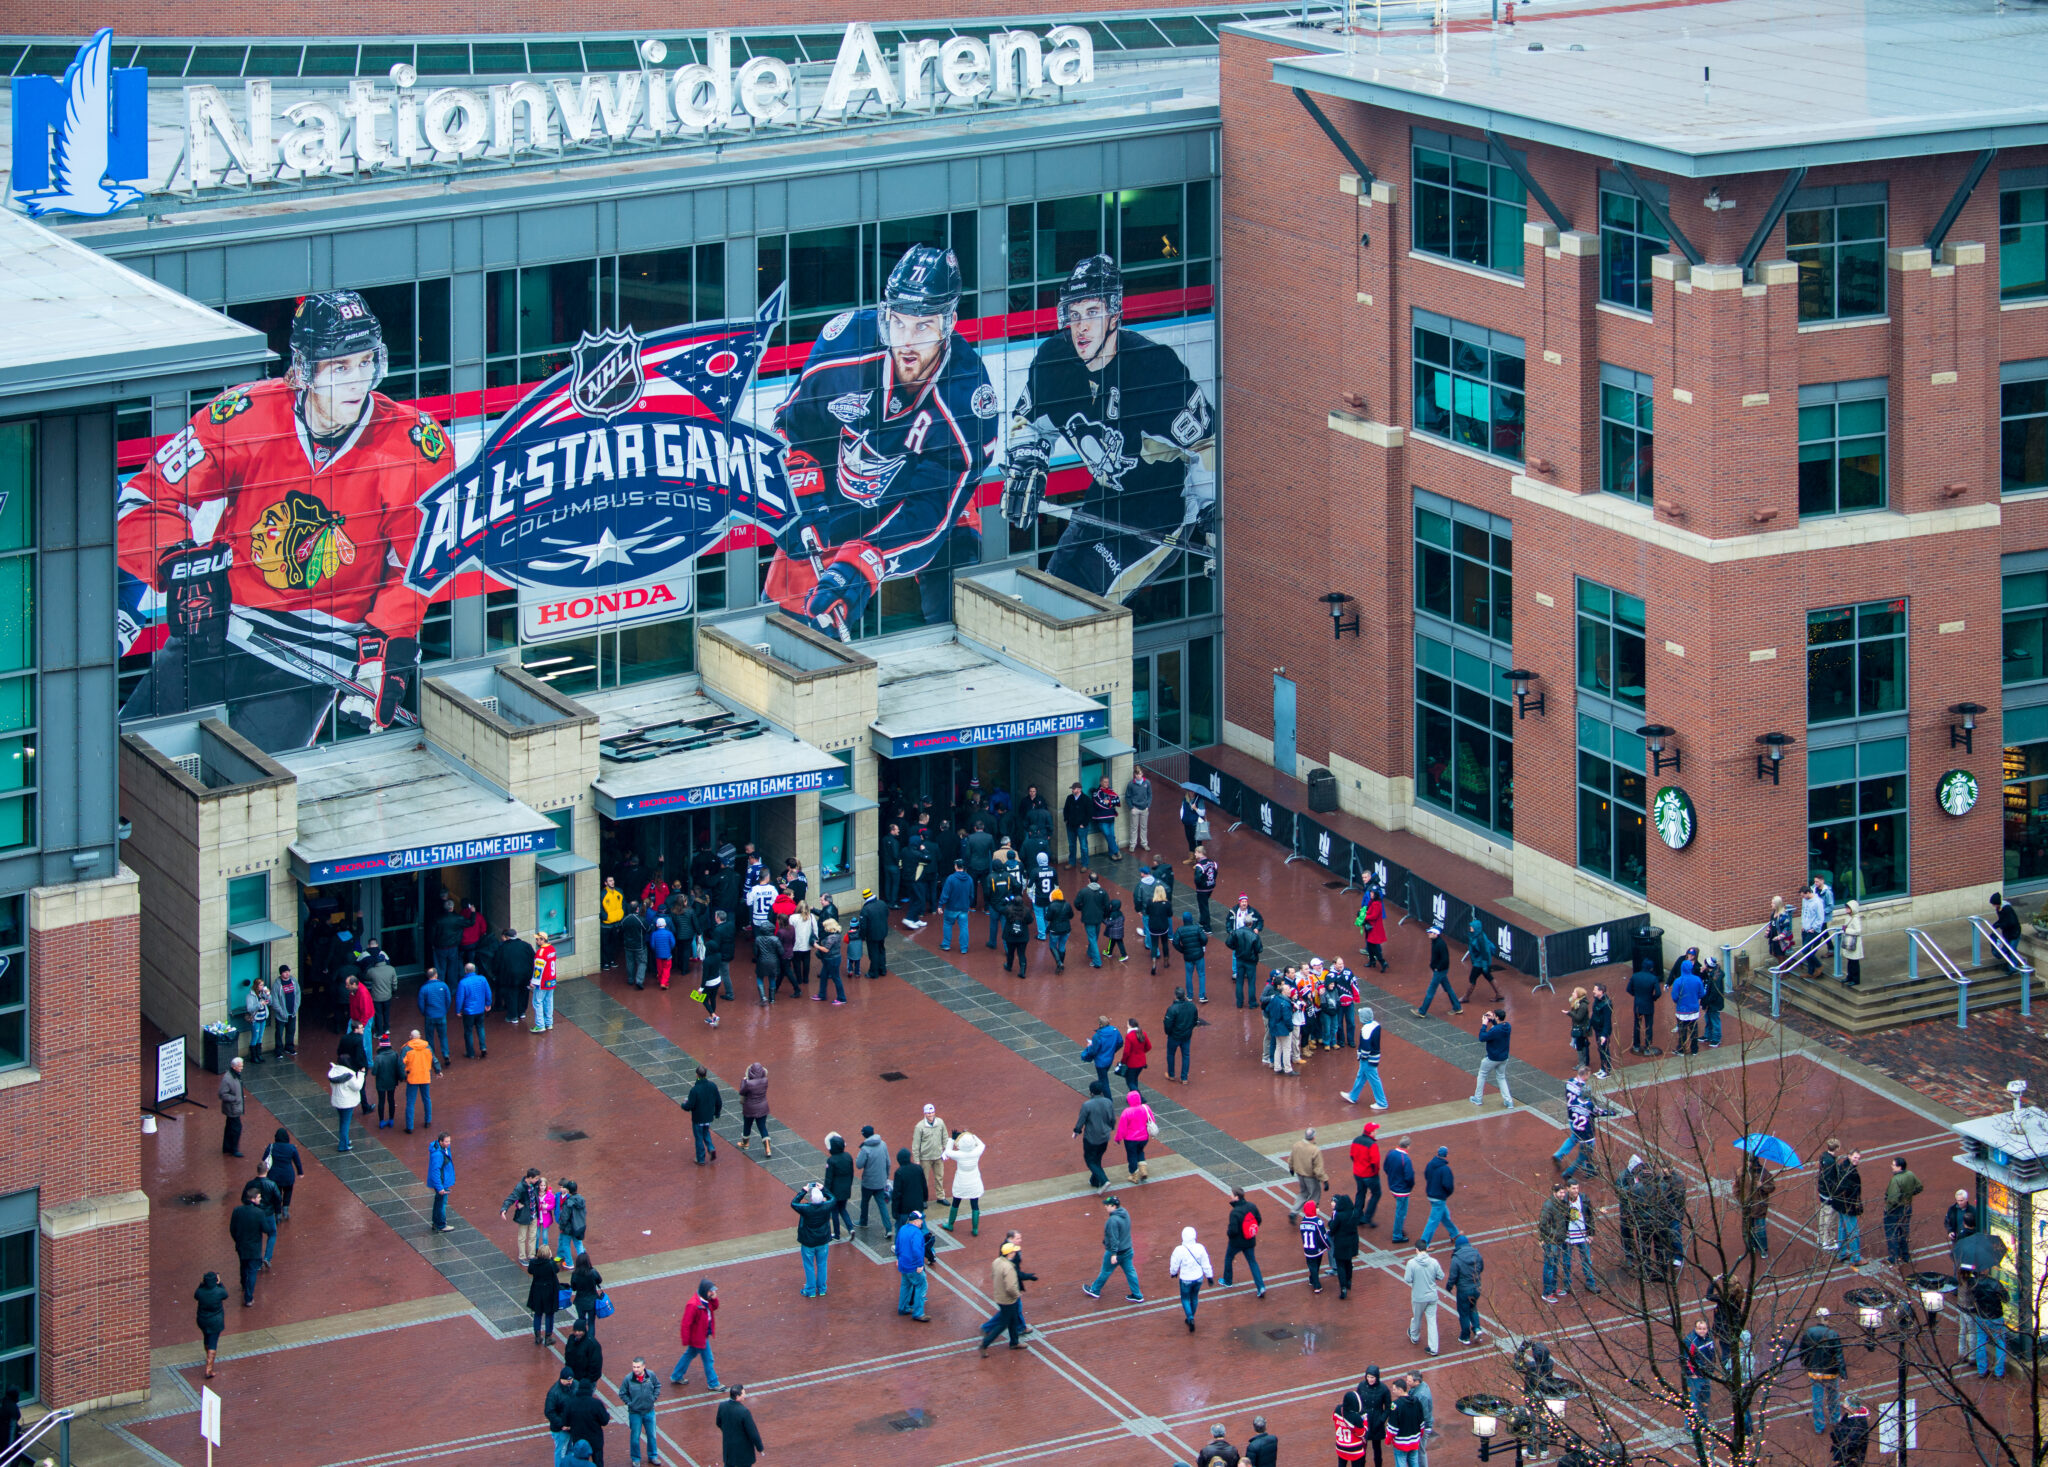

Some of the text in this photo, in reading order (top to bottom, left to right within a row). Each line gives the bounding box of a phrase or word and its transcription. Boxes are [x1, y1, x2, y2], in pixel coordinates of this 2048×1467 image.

[183, 22, 1094, 181] Nationwide Arena
[910, 265, 926, 284] 71
[340, 303, 363, 319] 88
[587, 352, 632, 405] NHL
[1171, 384, 1211, 446] 87
[154, 424, 206, 484] 88
[653, 424, 788, 512] GAME
[501, 490, 712, 548] COLUMBUS 2015
[1092, 541, 1122, 576] Reebok
[537, 583, 676, 626] HONDA
[1079, 681, 1119, 694] ICKETS
[819, 735, 863, 750] ICKETS
[914, 735, 958, 747] HONDA
[1027, 720, 1057, 735] GAME
[1059, 714, 1084, 730] 2015
[639, 795, 687, 808] HONDA
[761, 776, 794, 793] GAME
[796, 772, 822, 789] 2015
[218, 857, 280, 876] TICKETS
[335, 859, 386, 873] HONDA
[466, 838, 501, 857] GAME
[504, 834, 532, 852] 2015
[1042, 878, 1051, 893] 9
[756, 897, 772, 913] 15
[1572, 1112, 1587, 1131] 22
[1303, 1231, 1316, 1249] 11
[1336, 1426, 1352, 1443] 40
